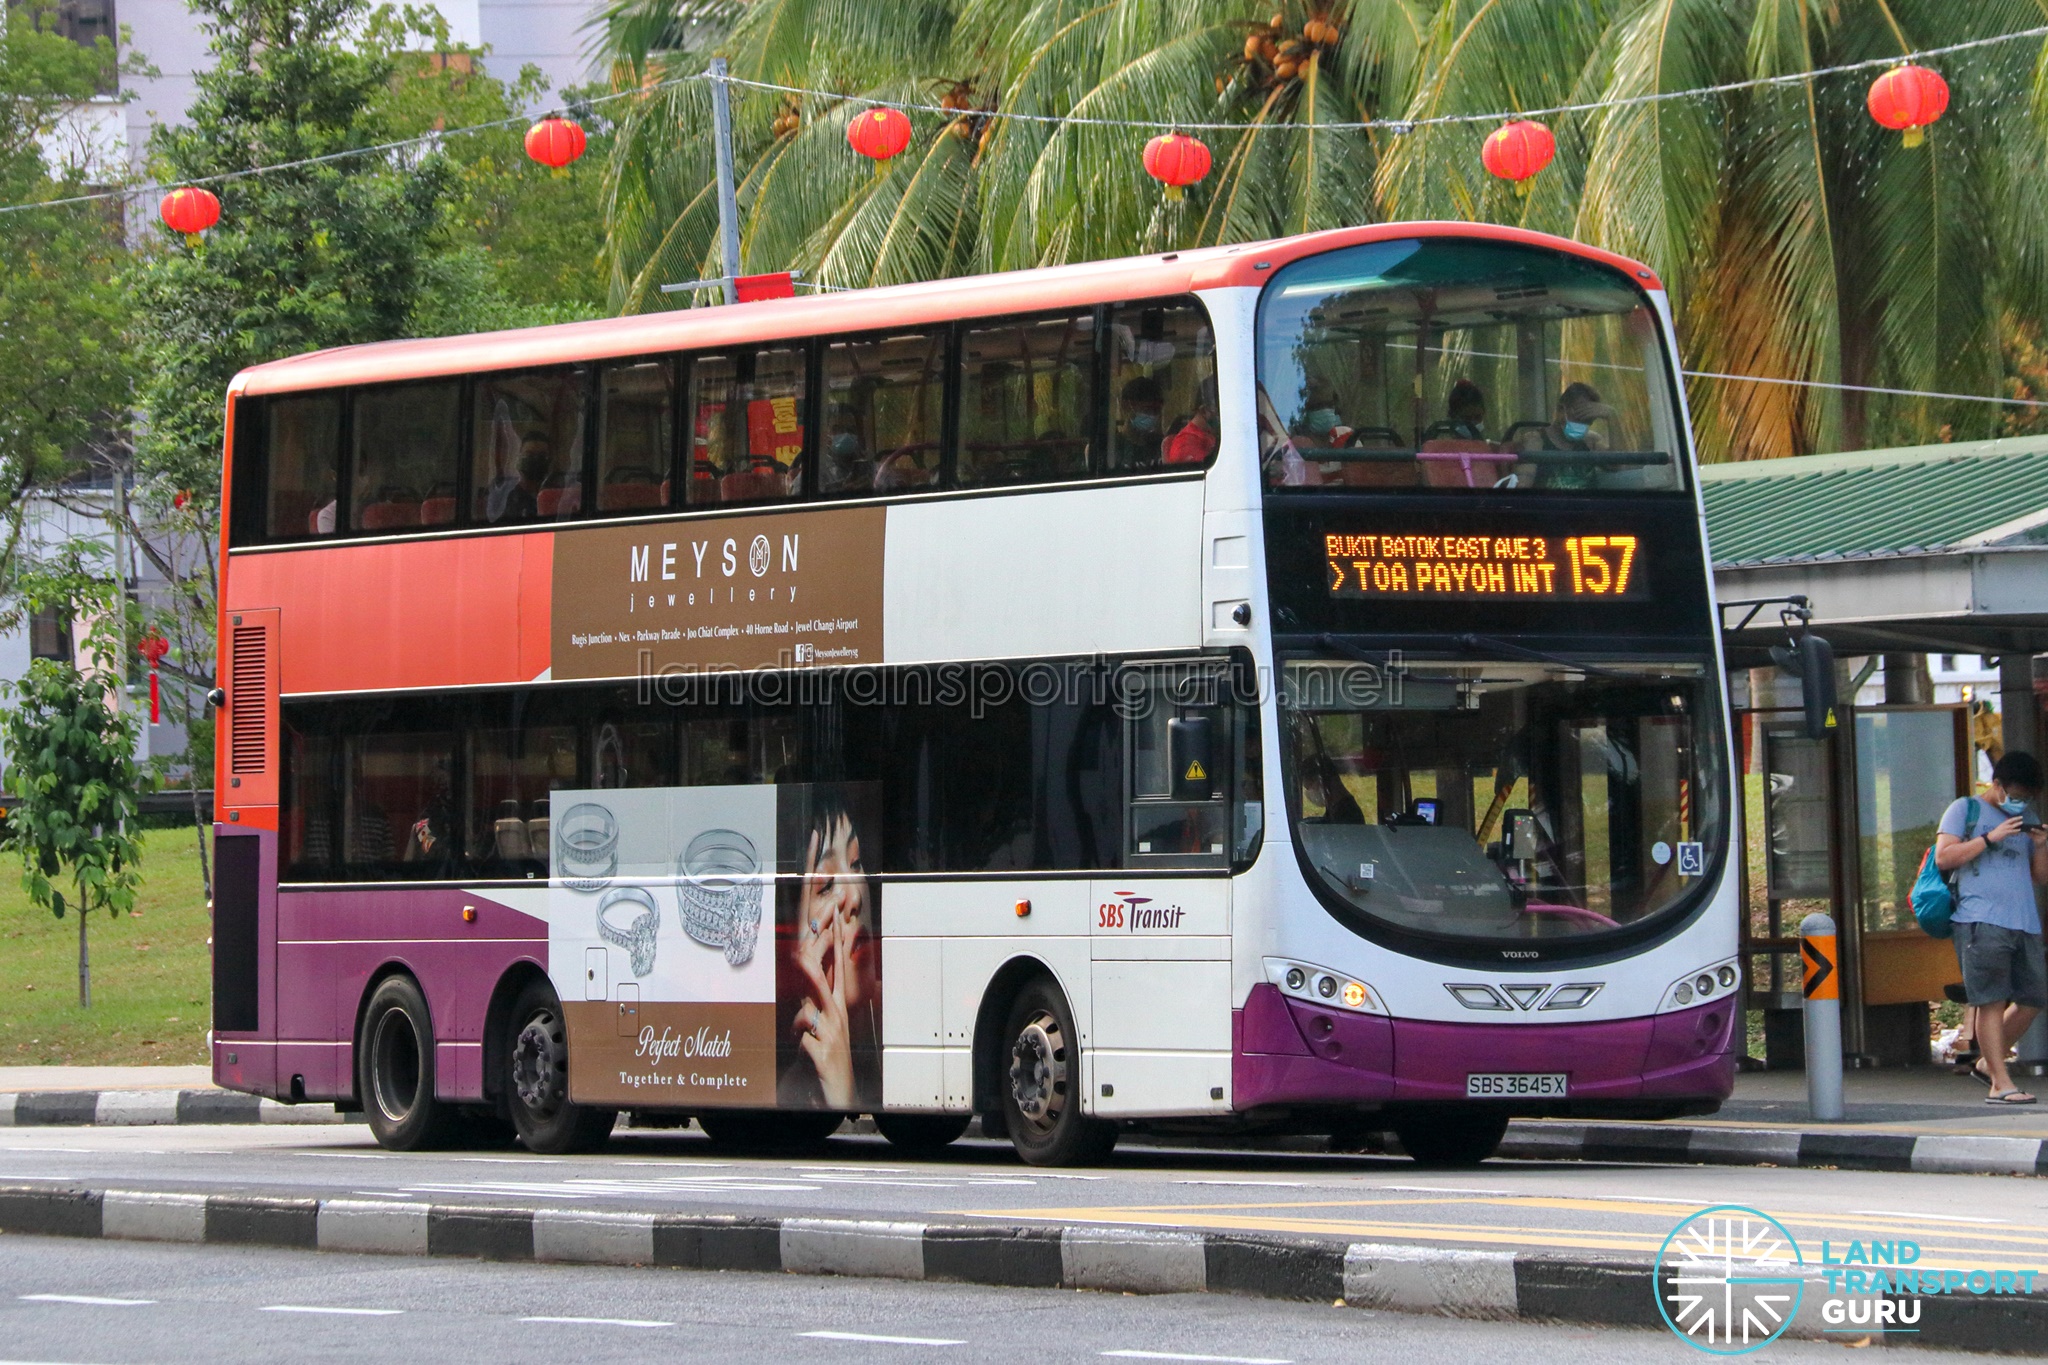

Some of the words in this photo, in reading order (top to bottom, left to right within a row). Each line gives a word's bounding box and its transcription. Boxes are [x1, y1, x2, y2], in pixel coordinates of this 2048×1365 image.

[630, 534, 799, 583] MEYSON
[1326, 535, 1377, 557] BUKIT
[1381, 536, 1441, 558] BATOK
[1444, 537, 1490, 559] EAST
[1494, 537, 1531, 559] AVE
[1533, 538, 1546, 559] 3
[1353, 561, 1409, 591] TOA
[1415, 562, 1506, 593] PAYOH
[1512, 563, 1556, 593] INT
[1565, 536, 1637, 594] 157
[630, 585, 797, 612] jewellery
[571, 633, 587, 648] Bugis
[588, 631, 612, 646] Junction
[618, 632, 630, 642] Nex
[636, 629, 660, 644] Parkway
[661, 628, 681, 641] Parade
[687, 627, 697, 640] Joo
[697, 625, 713, 638] Chiat
[713, 625, 739, 639] Complex
[745, 624, 754, 635] 40
[754, 623, 773, 635] Horne
[773, 621, 789, 634] Road
[795, 620, 813, 635] Jewel
[813, 618, 835, 634] Changi
[836, 617, 859, 633] Airport
[1098, 903, 1124, 928] SBS
[1123, 897, 1186, 934] Transit
[1501, 951, 1540, 959] VOLVO
[635, 1025, 682, 1066] Perfect
[684, 1026, 732, 1058] Match
[619, 1071, 673, 1088] Together
[677, 1073, 685, 1085] &
[690, 1072, 748, 1090] Complete
[1469, 1077, 1565, 1094] SBS3645X
